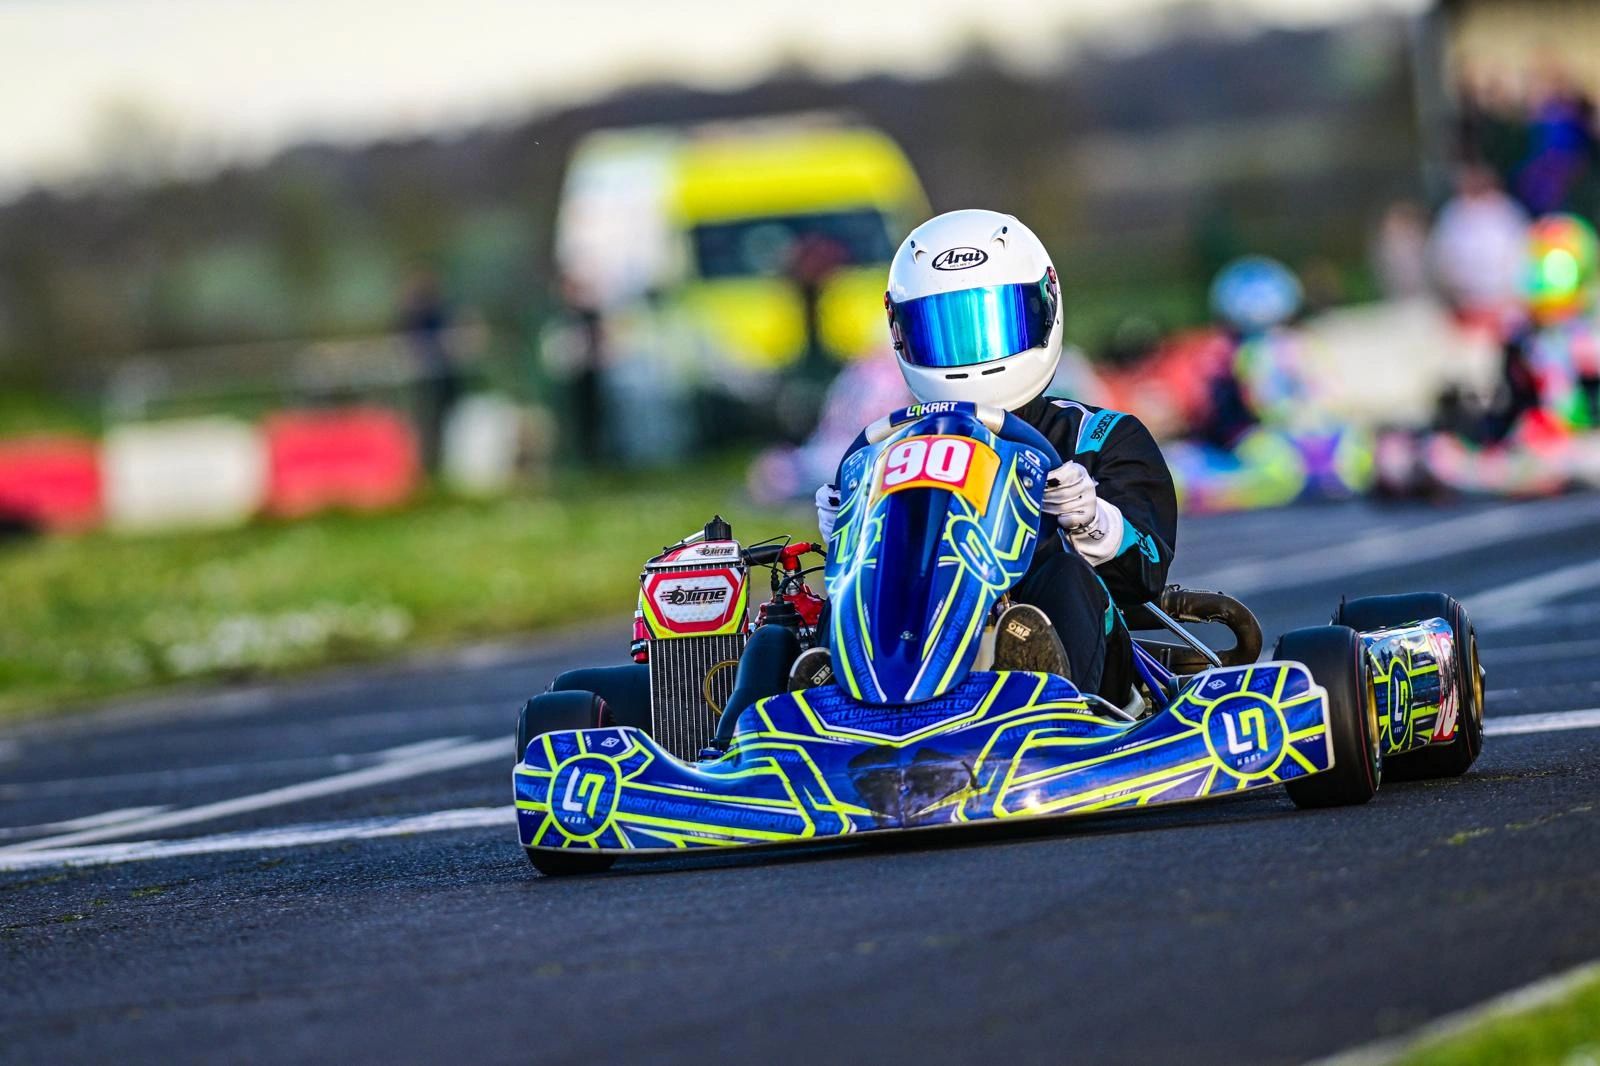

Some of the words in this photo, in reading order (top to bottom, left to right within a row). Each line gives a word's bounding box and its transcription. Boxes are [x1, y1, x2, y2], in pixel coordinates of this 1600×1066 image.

[936, 249, 982, 268] Arai
[884, 438, 972, 486] 90
[1008, 621, 1031, 638] OMP
[813, 666, 831, 686] OMP
[1237, 753, 1262, 766] KART
[564, 815, 586, 824] KART
